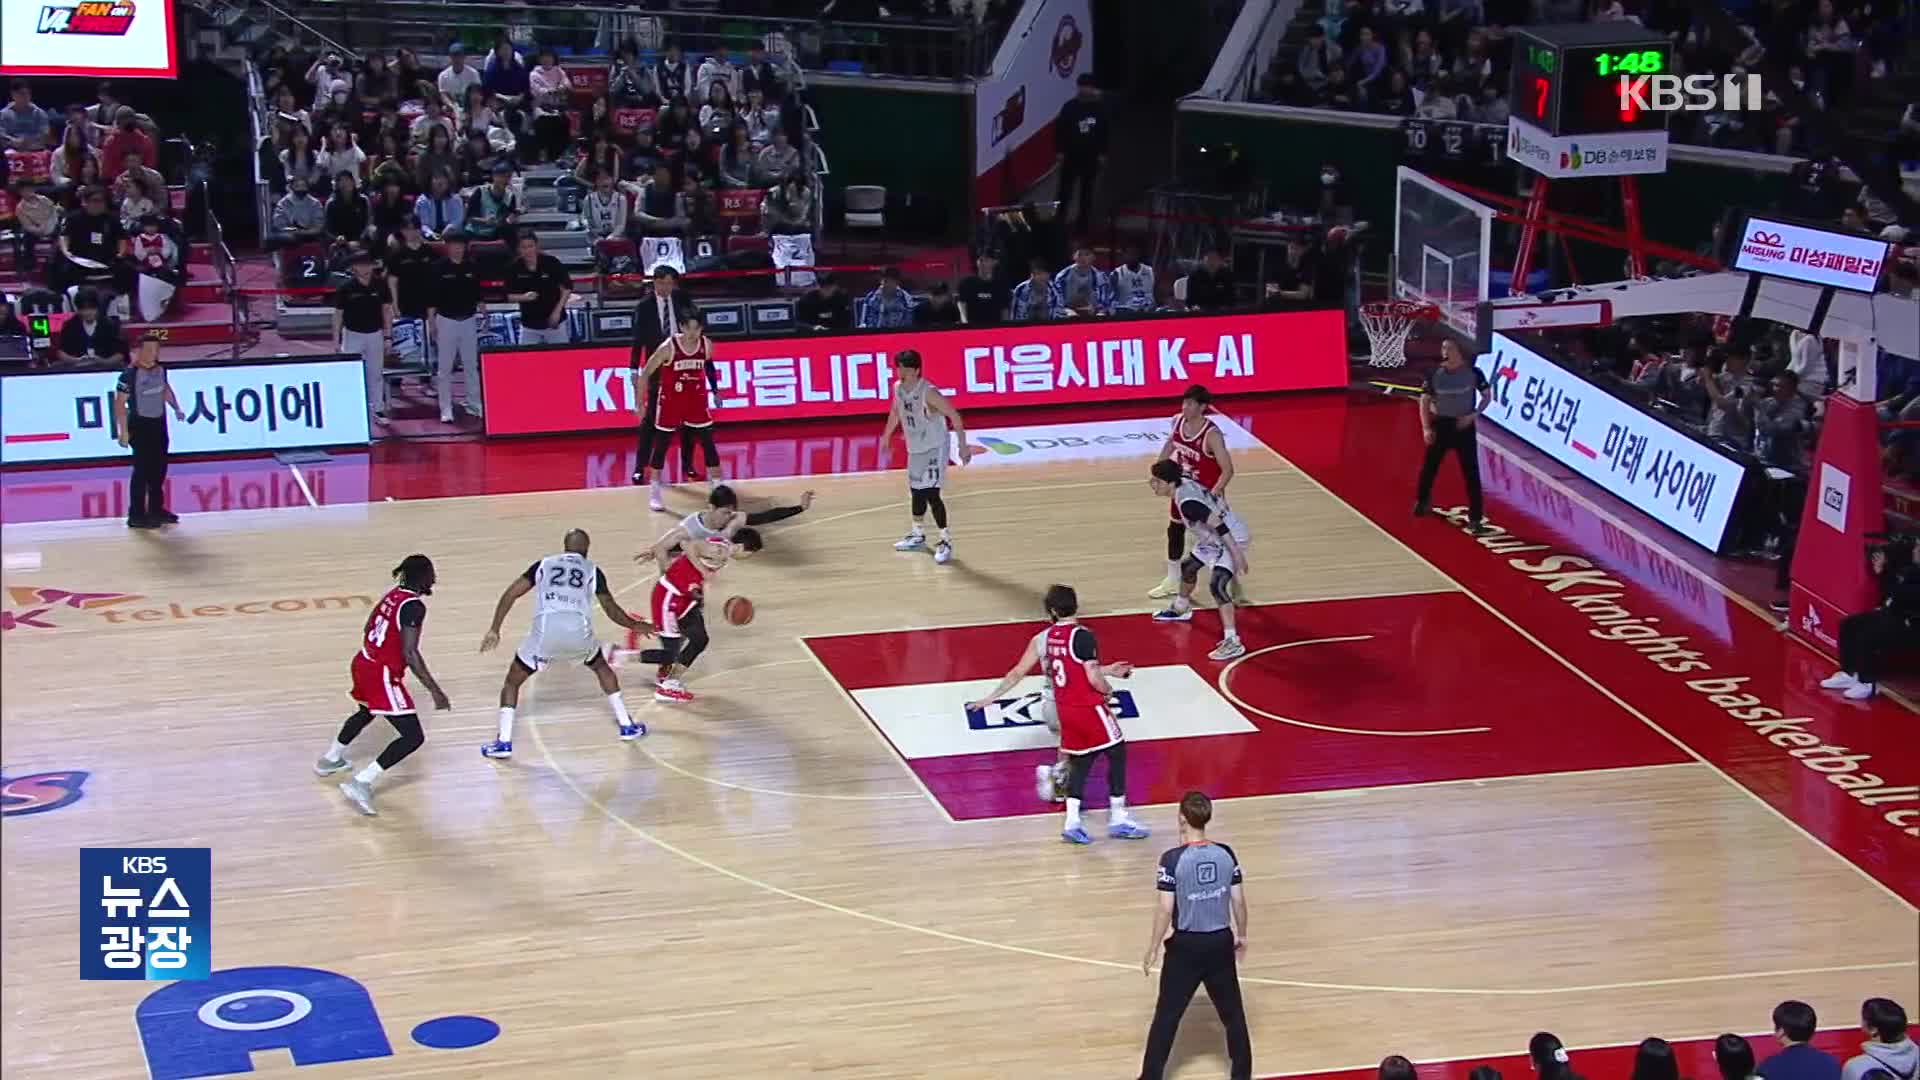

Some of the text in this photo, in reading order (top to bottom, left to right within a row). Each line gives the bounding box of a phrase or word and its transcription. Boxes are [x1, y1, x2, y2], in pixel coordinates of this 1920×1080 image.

[1595, 51, 1661, 75] 1:48
[1742, 245, 1786, 260] MISUNG
[1789, 247, 1881, 278] 미성패밀리
[33, 319, 48, 336] 4
[964, 339, 1145, 393] 다음시대
[1158, 333, 1254, 381] K-AI
[187, 381, 323, 434] 사이에
[1602, 422, 1648, 484] 미래
[1645, 449, 1717, 523] 사이에
[550, 567, 584, 588] 28
[97, 594, 374, 623] telecom
[1052, 659, 1067, 688] 3
[1508, 555, 1625, 592] SK
[1685, 677, 1920, 806] basketball
